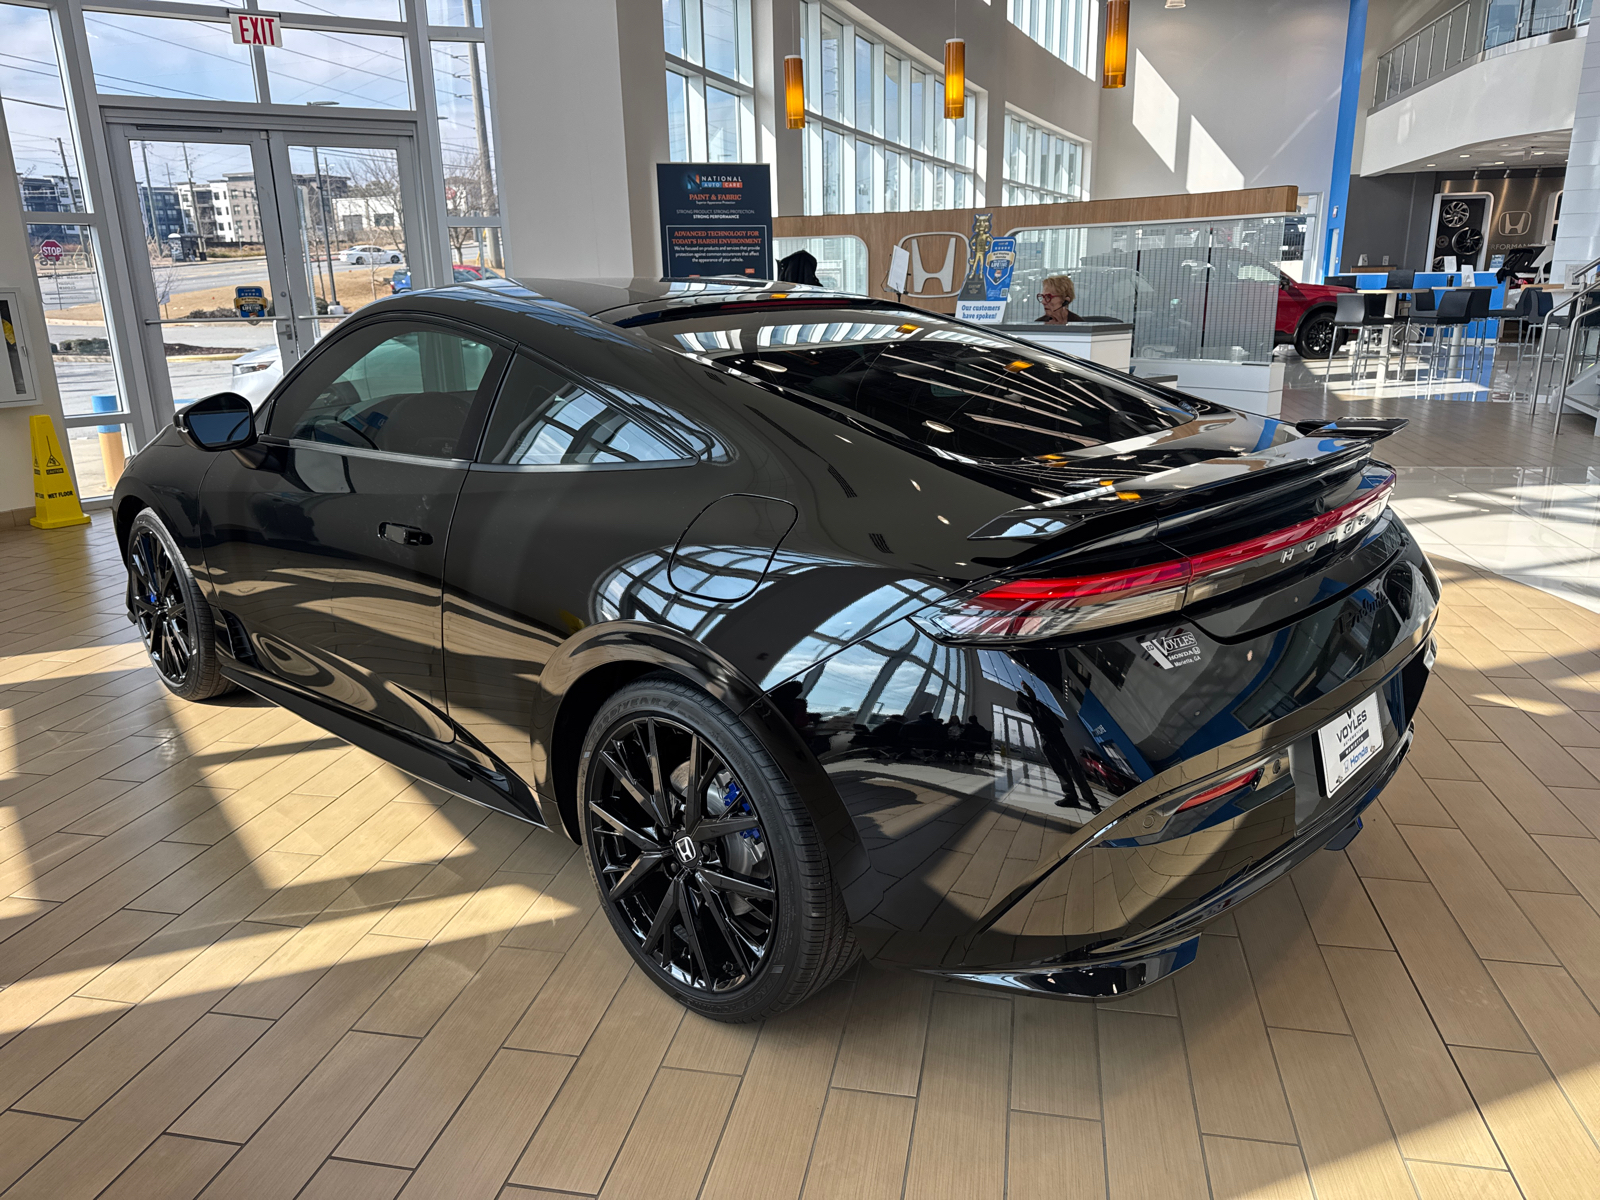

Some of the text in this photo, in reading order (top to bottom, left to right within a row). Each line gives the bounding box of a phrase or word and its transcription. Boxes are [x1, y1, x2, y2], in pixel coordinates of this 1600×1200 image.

[238, 16, 275, 45] EXIT
[42, 246, 62, 256] STOP
[1152, 634, 1194, 656] VOYLES
[1168, 650, 1194, 660] HONDA
[1336, 710, 1368, 742] VOYLES
[1350, 746, 1369, 768] Honda
